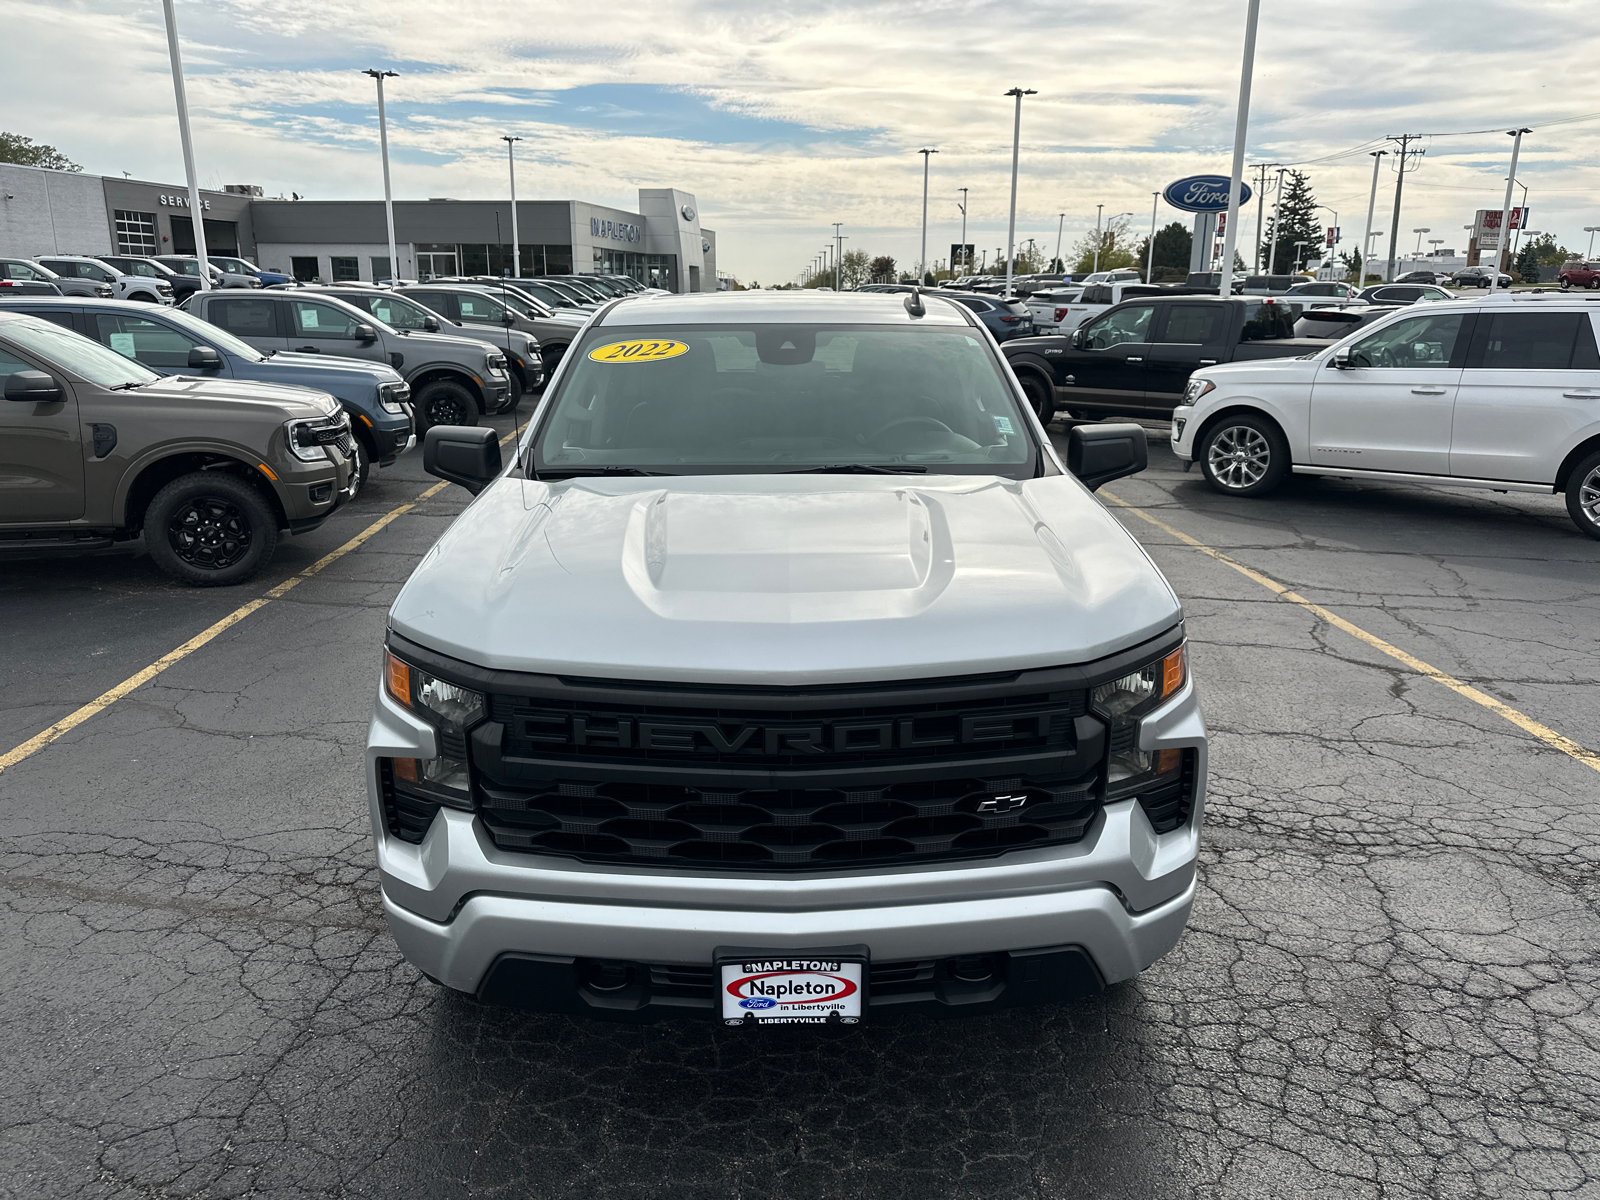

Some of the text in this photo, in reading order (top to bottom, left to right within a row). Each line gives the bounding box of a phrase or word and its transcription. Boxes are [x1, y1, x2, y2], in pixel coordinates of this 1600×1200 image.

[160, 194, 211, 210] SERVCE
[591, 217, 641, 243] NAPLETON
[604, 342, 676, 358] 2022
[512, 702, 1072, 756] CHEVROLET
[750, 961, 833, 972] NAPLETON
[749, 980, 836, 999] Napleton
[746, 999, 770, 1008] Ford
[792, 1003, 846, 1012] Libertyville
[758, 1017, 827, 1025] LIBERTYVILLE
